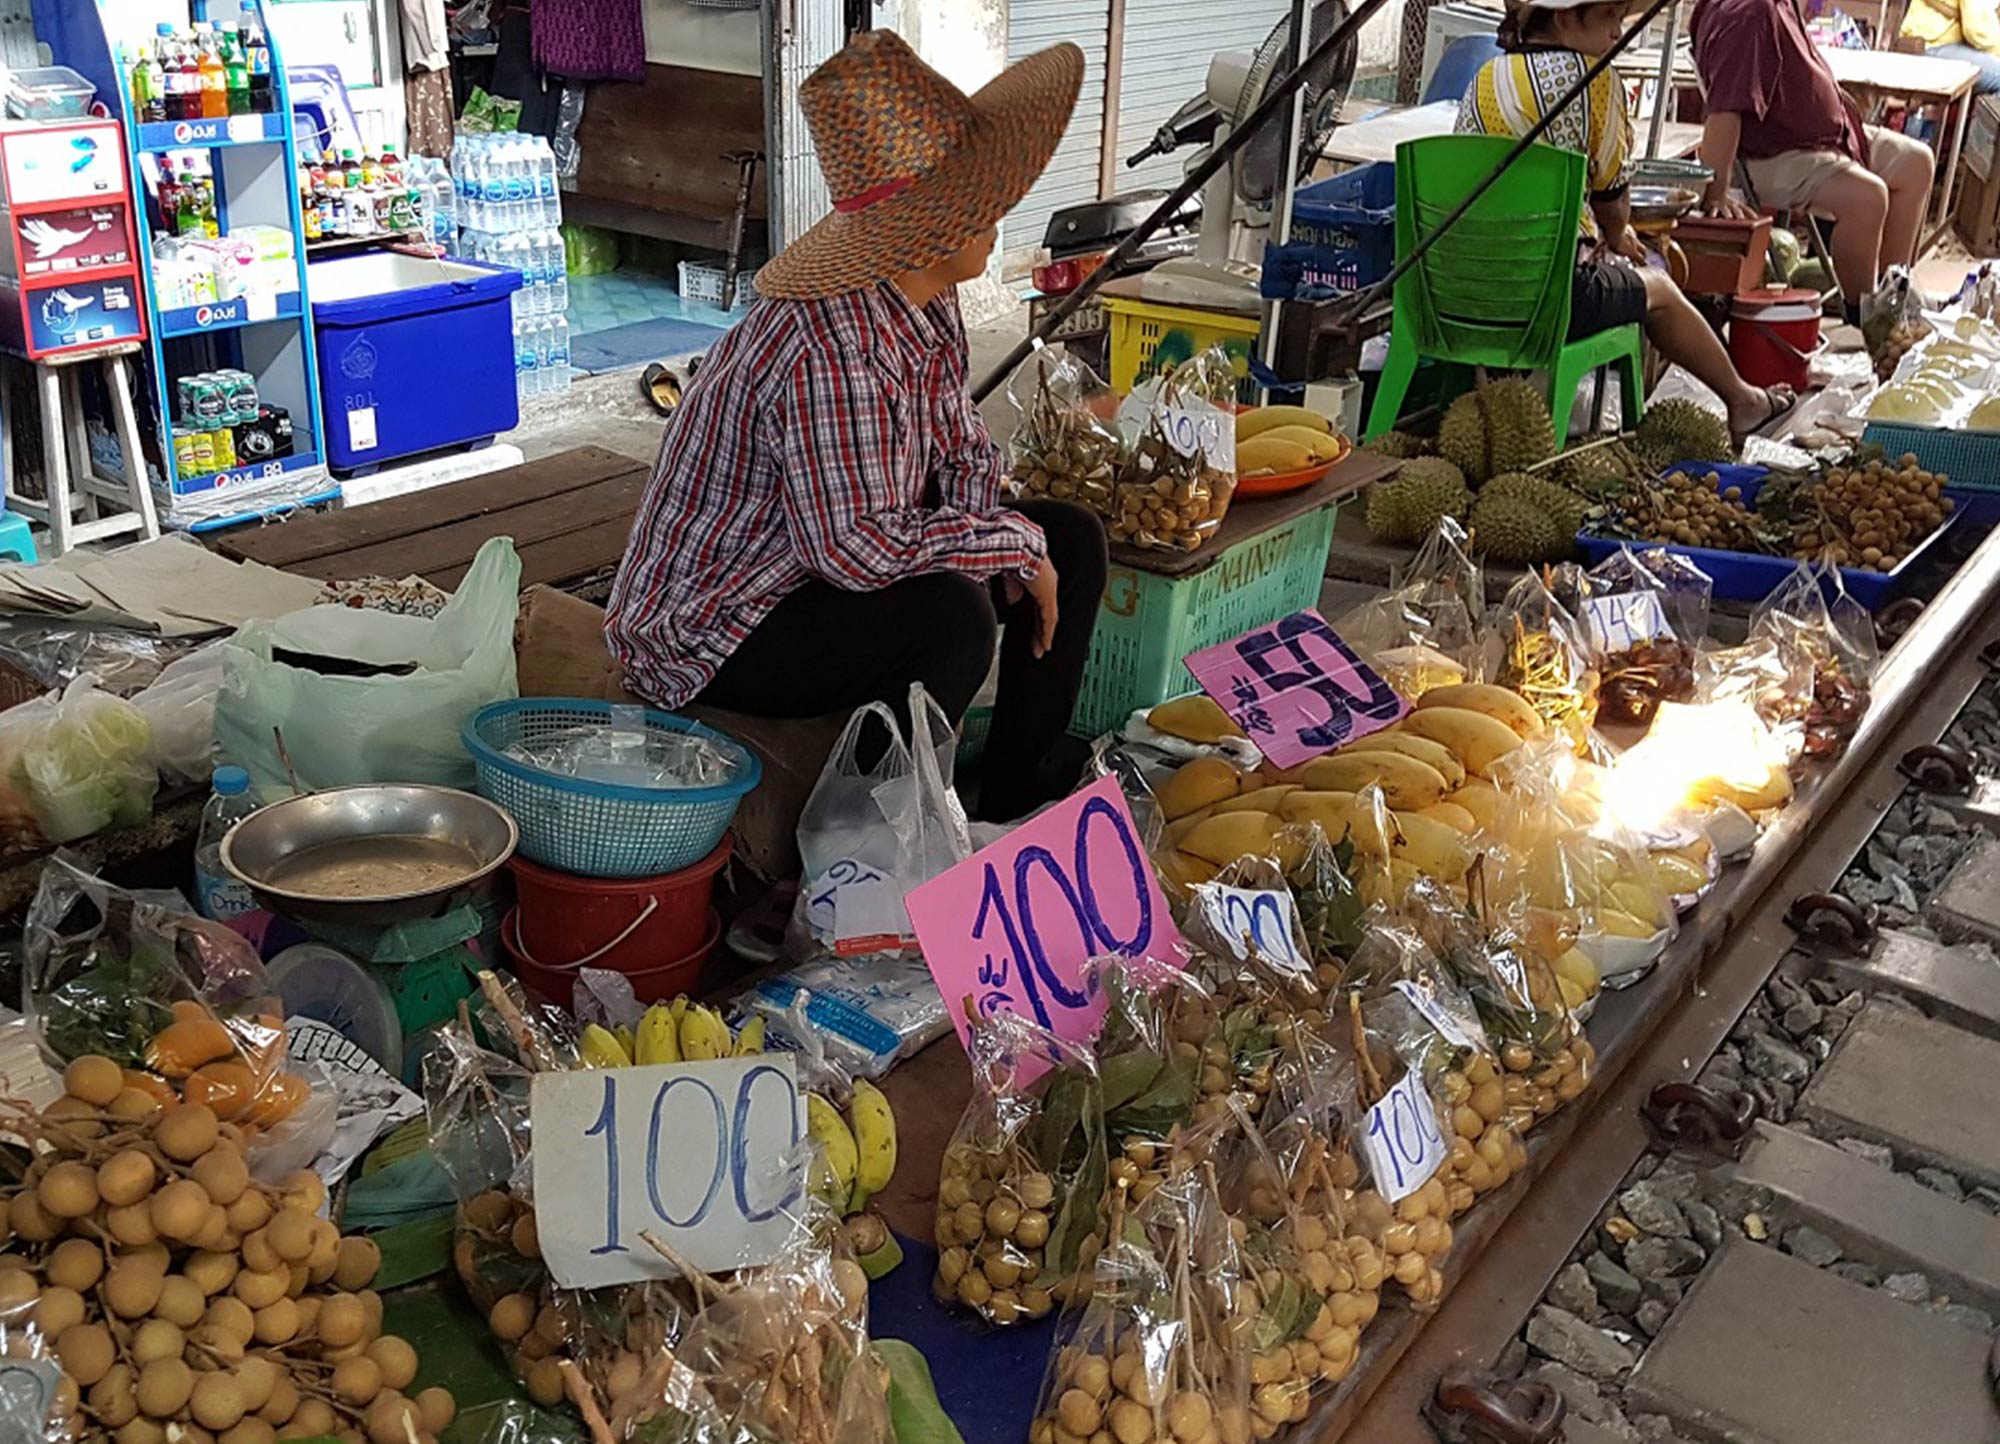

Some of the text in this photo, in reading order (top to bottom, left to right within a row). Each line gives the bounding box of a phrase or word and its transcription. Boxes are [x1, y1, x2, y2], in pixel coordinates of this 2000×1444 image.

[344, 394, 365, 411] 80
[1160, 410, 1220, 455] 100
[1235, 612, 1401, 748] 50
[973, 796, 1153, 1063] 100
[584, 1065, 804, 1255] 100
